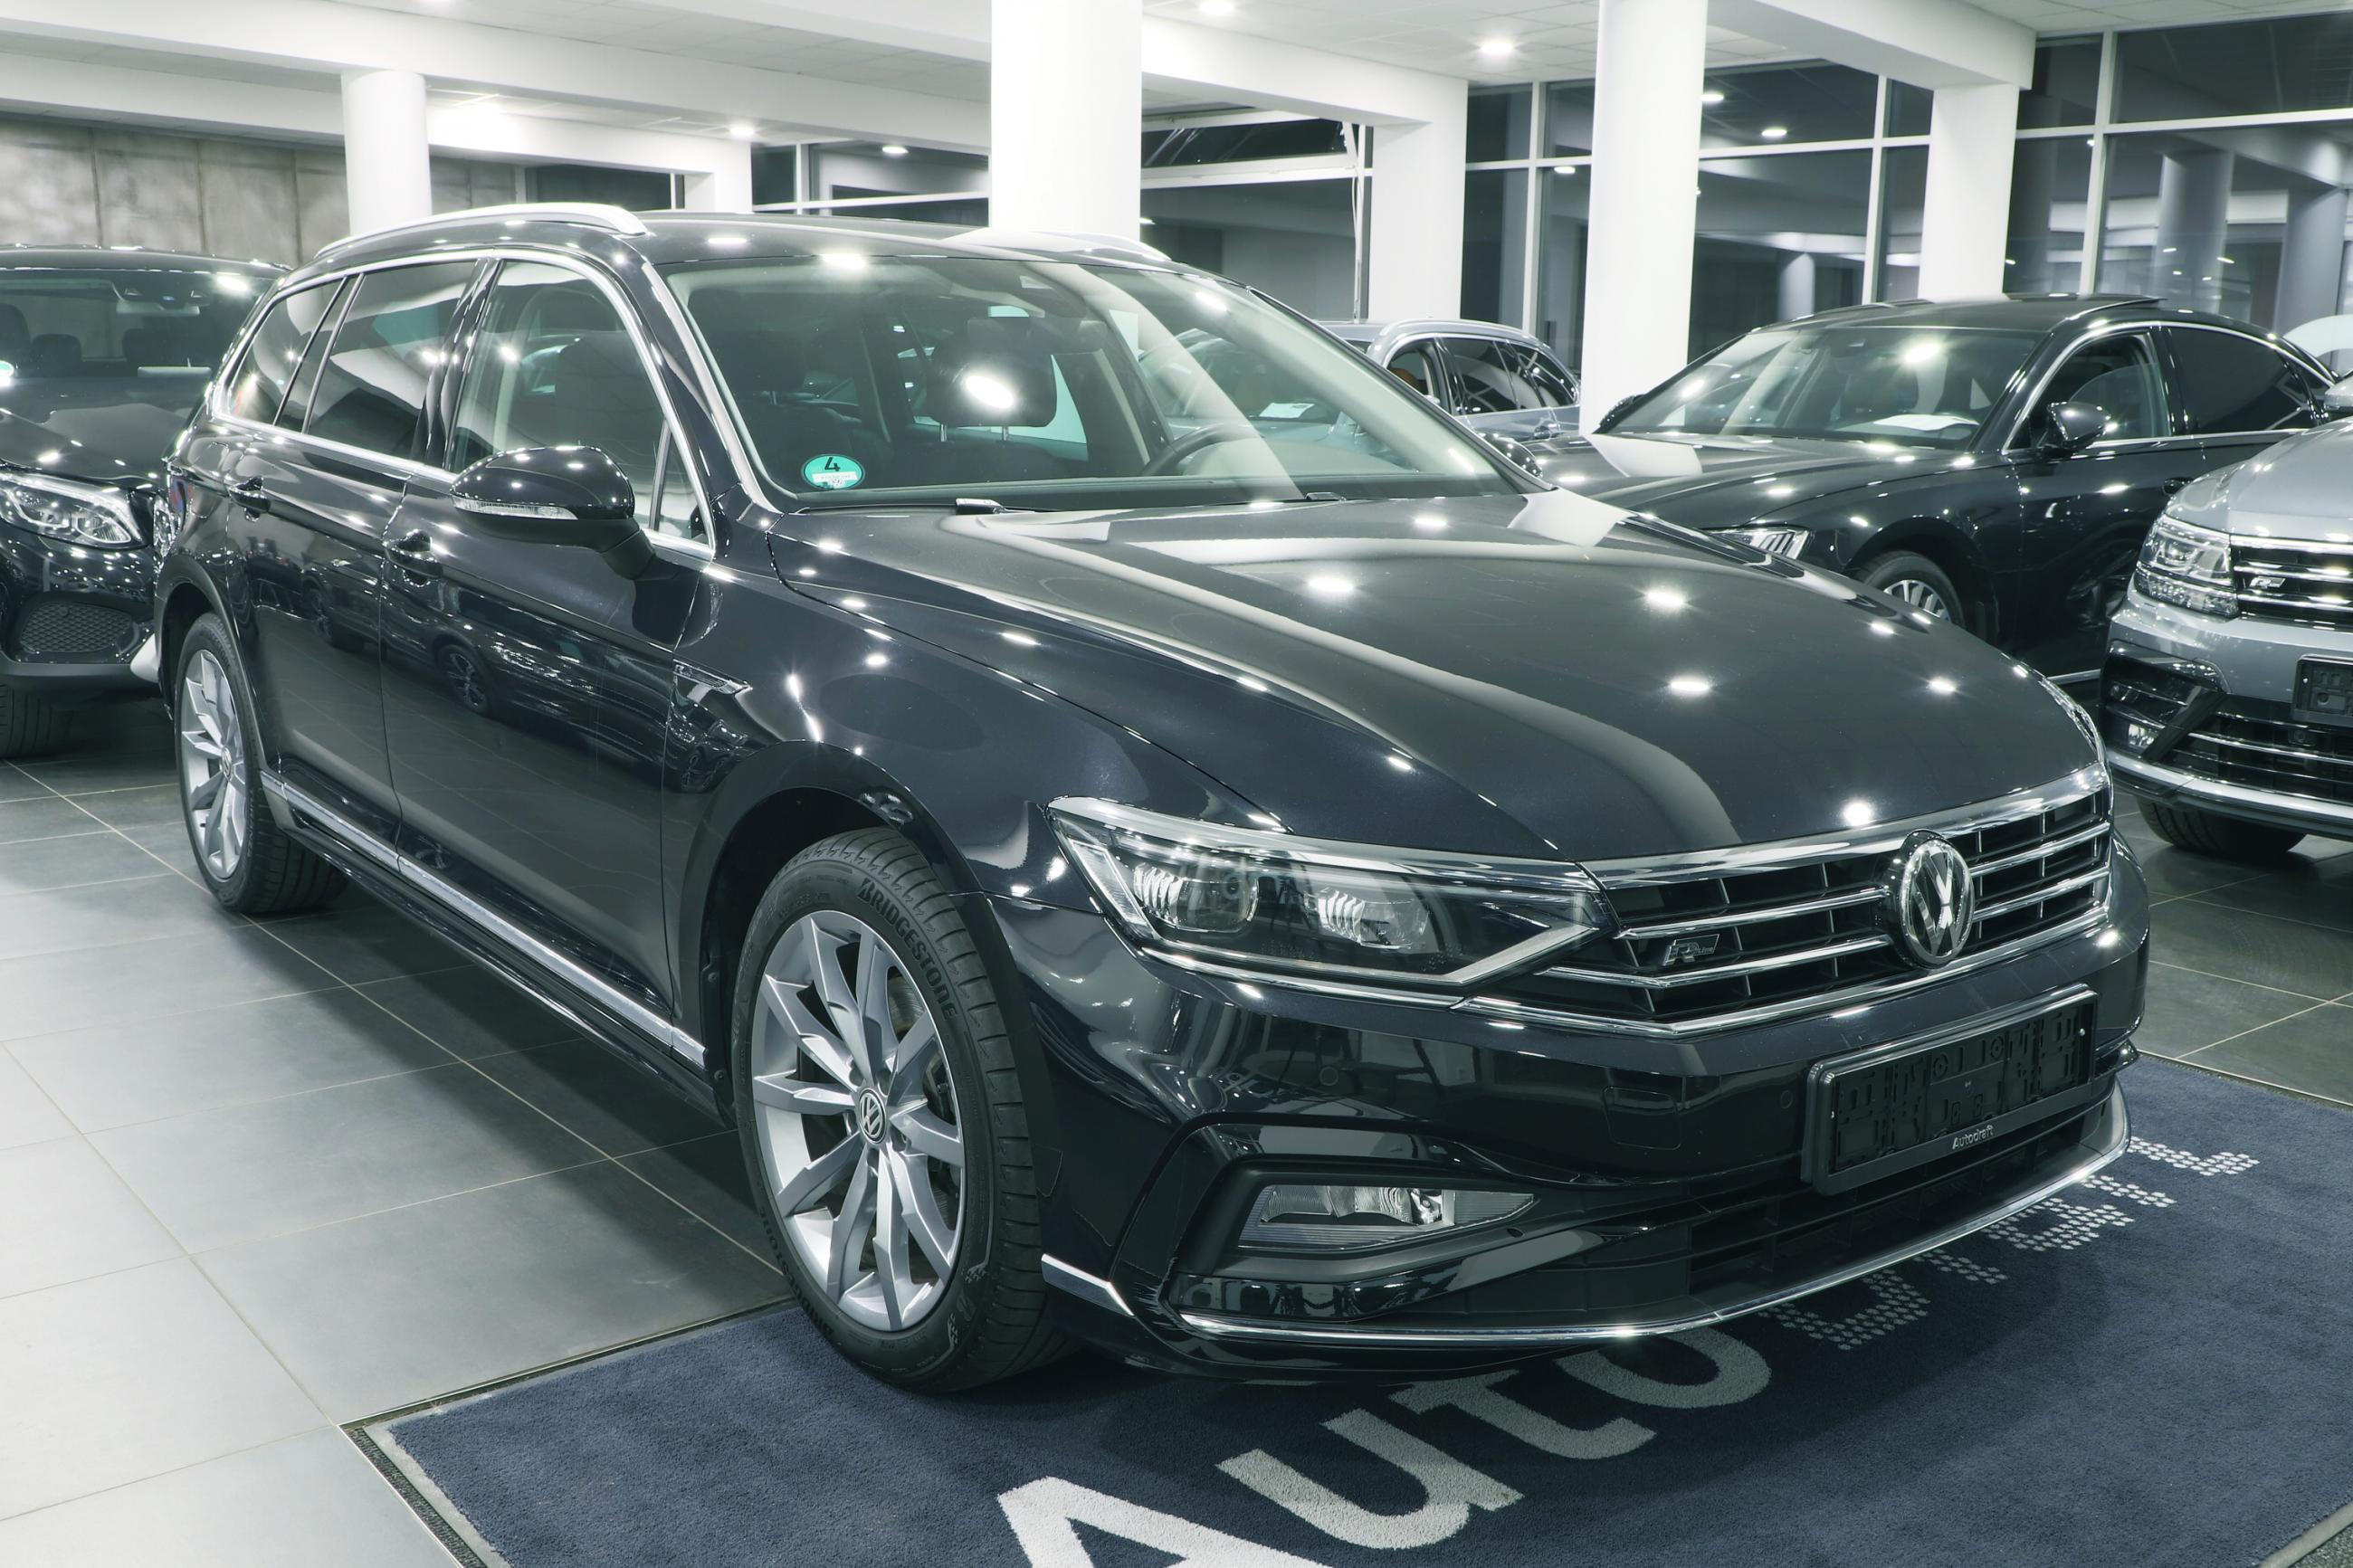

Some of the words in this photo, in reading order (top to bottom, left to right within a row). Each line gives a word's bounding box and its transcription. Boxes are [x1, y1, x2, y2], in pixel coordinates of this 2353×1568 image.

[824, 456, 841, 472] 4
[856, 878, 957, 1020] BRIDGESTONE
[1951, 1124, 1995, 1150] Autodraft
